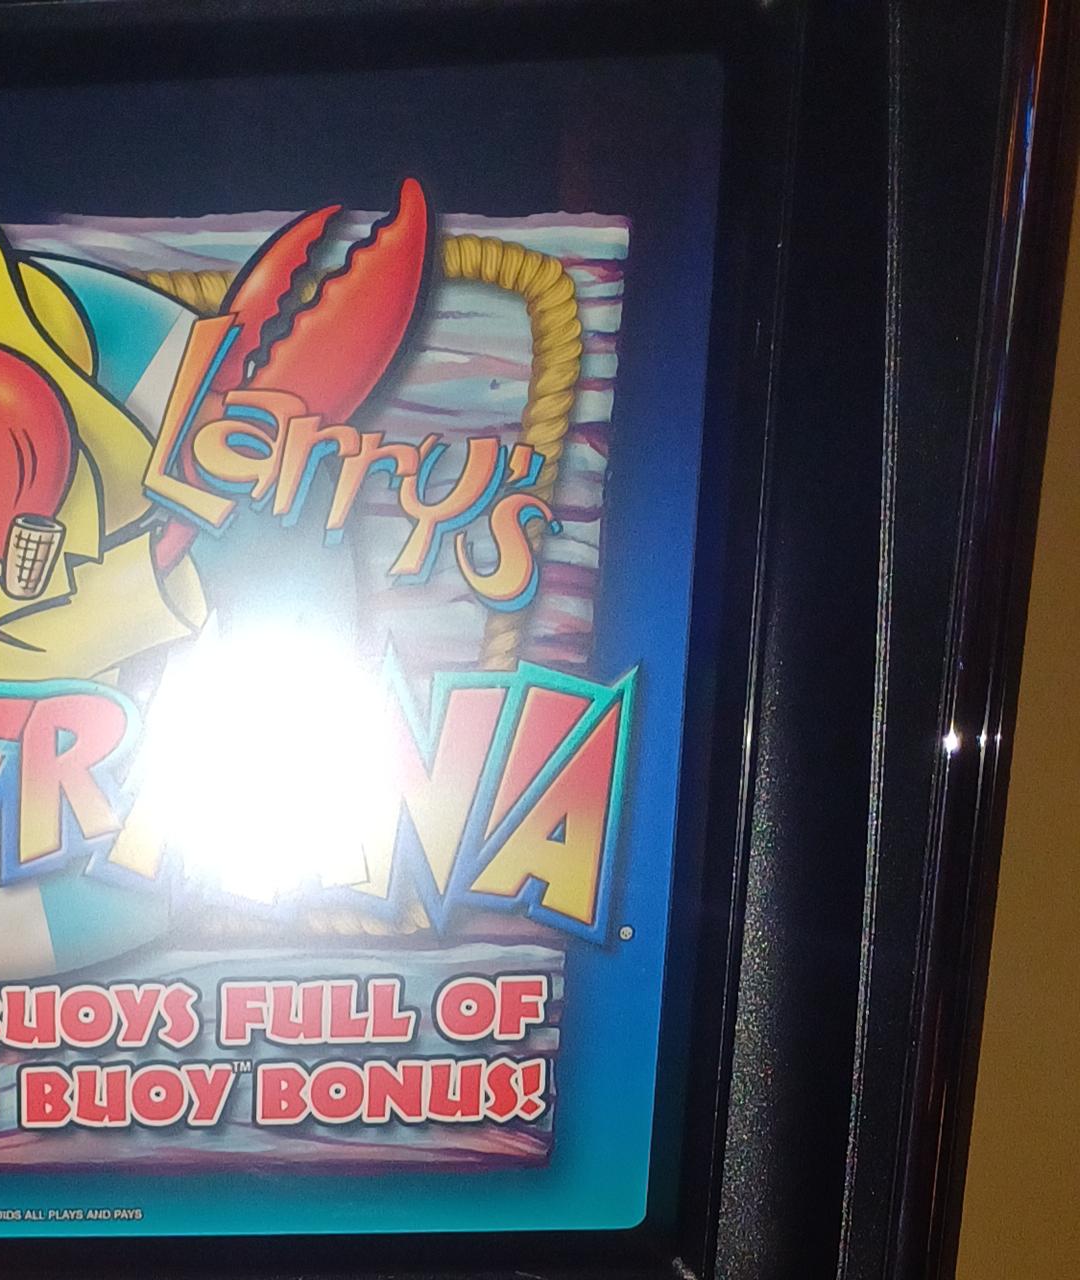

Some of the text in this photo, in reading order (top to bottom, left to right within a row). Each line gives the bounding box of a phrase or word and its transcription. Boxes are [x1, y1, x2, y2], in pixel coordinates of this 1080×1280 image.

[143, 312, 562, 610] Larry's
[219, 975, 417, 1046] FULL
[435, 973, 554, 1042] OF
[254, 1056, 547, 1126] BONUS!
[24, 1210, 45, 1221] ALL
[48, 1209, 83, 1220] PLAYS
[86, 1209, 111, 1220] AND
[114, 1208, 142, 1220] PAYS
